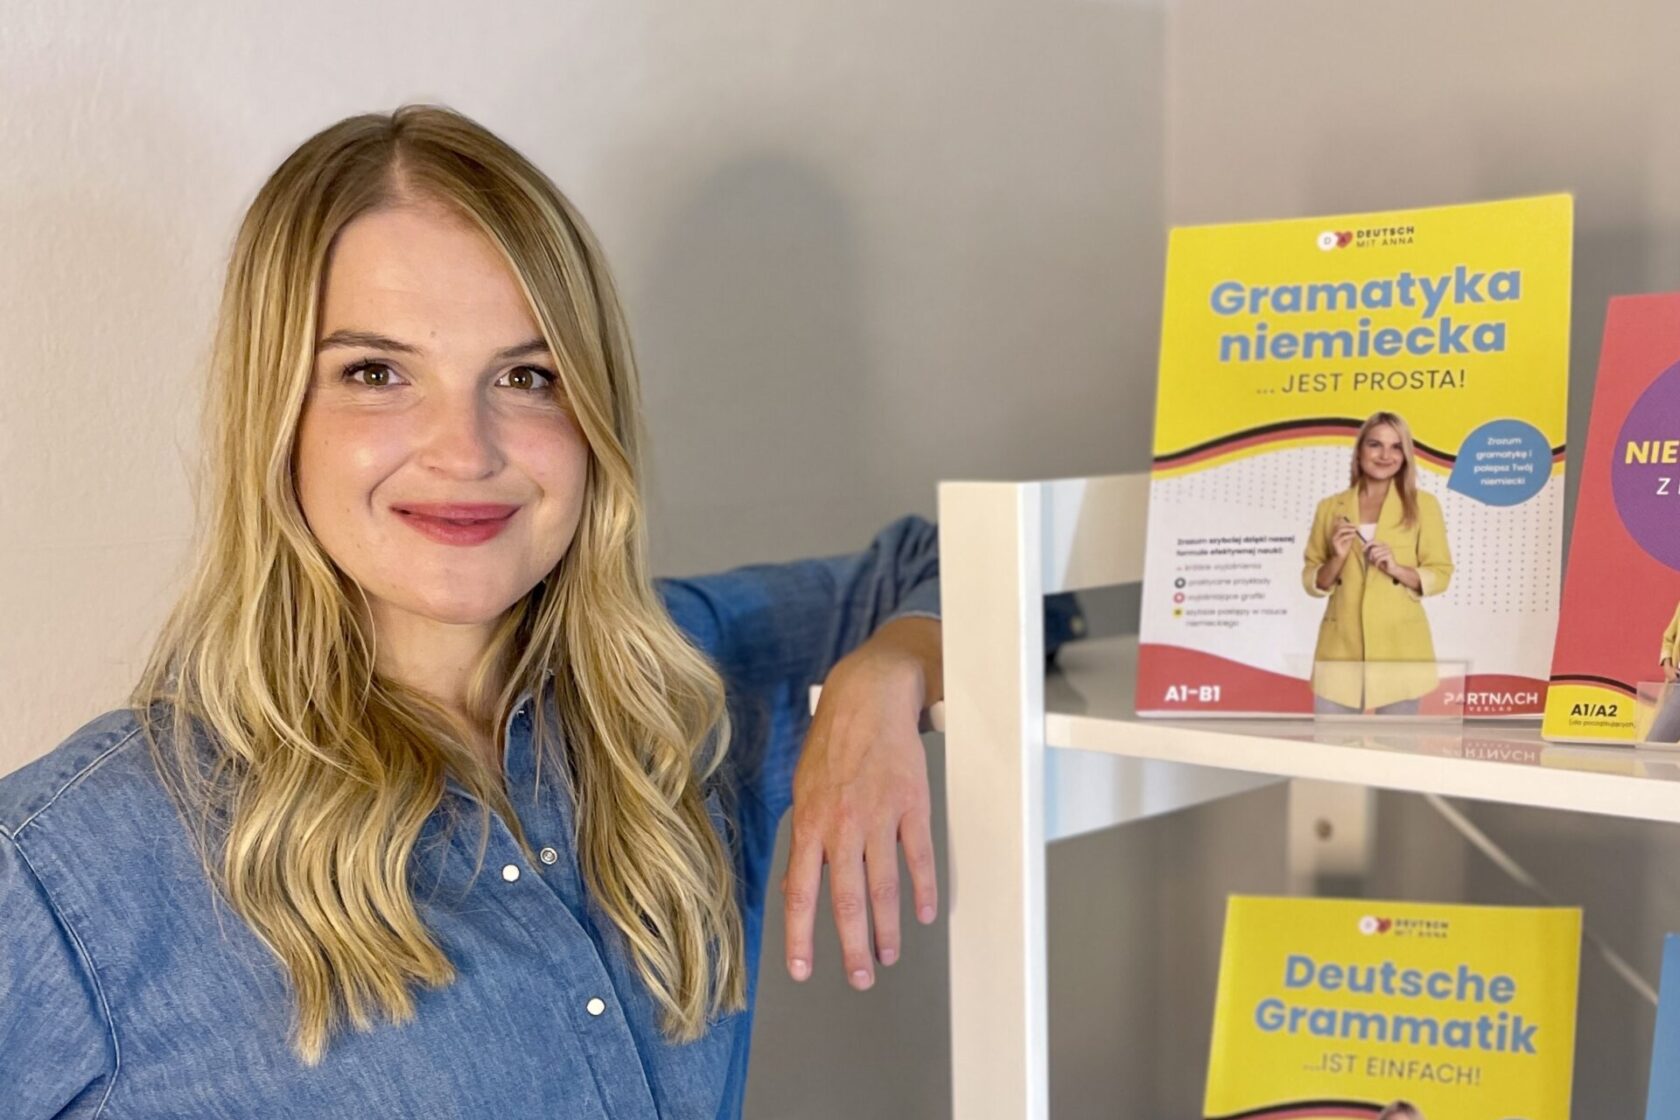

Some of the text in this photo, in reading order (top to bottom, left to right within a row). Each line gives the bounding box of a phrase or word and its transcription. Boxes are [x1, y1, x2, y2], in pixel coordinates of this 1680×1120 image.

[1356, 226, 1415, 239] DEUTSCH
[1382, 236, 1414, 247] ANNA
[1210, 265, 1521, 319] Gramatyka
[1219, 316, 1506, 362] niemiecka
[1353, 368, 1465, 391] PROSTA!
[1625, 440, 1680, 464] NIE
[1656, 477, 1671, 495] Z
[1164, 684, 1221, 702] A1-B1
[1443, 692, 1539, 705] PARTNACH
[1570, 703, 1618, 717] A1/A2
[1284, 954, 1516, 1004] Deutsche
[1255, 997, 1539, 1055] Grammatik
[1366, 1056, 1481, 1086] EINFACH!
